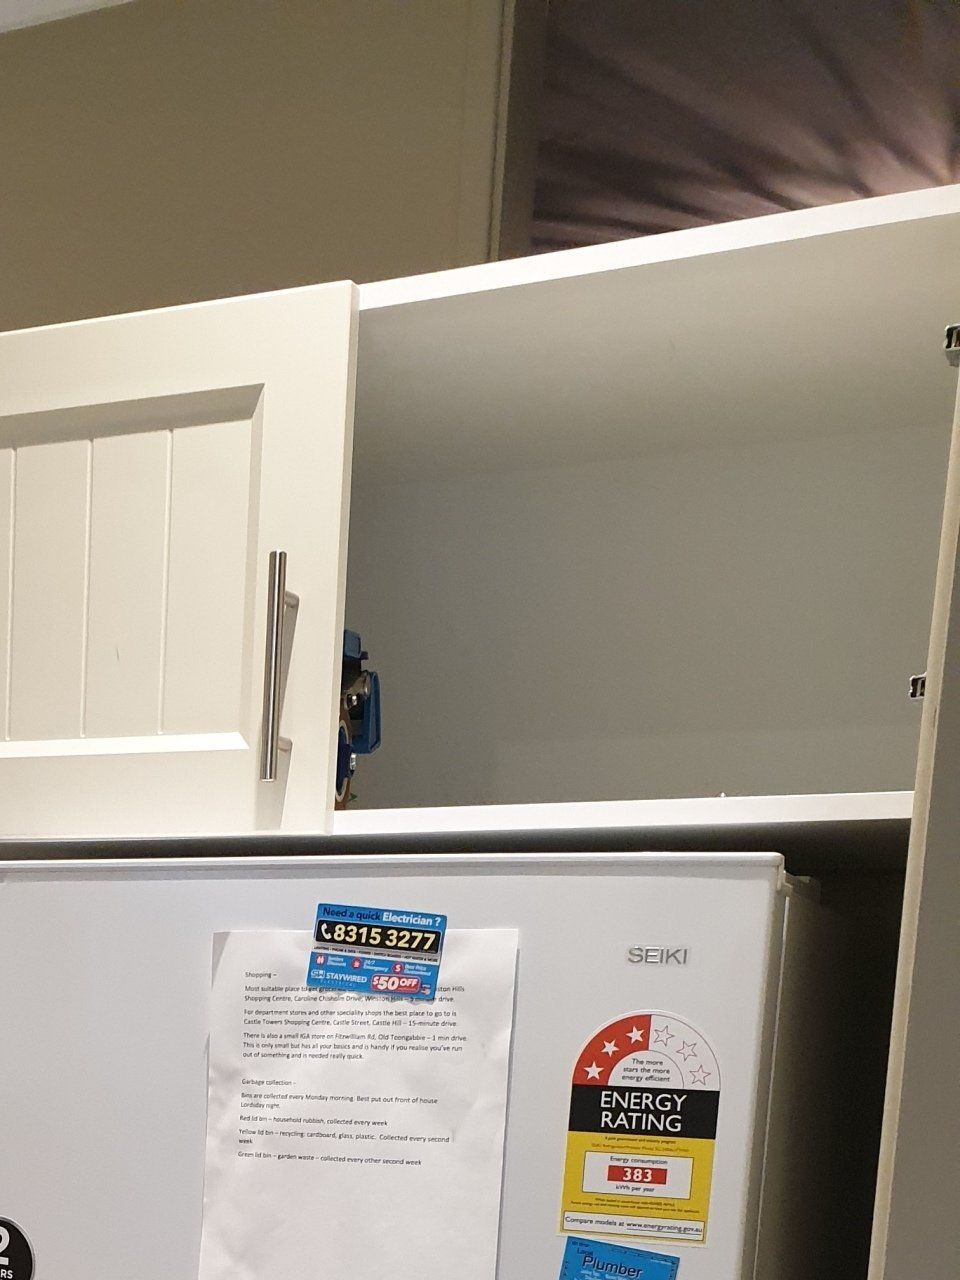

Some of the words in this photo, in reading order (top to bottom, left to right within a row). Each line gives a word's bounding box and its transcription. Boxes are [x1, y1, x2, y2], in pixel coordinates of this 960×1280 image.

[323, 907, 346, 916] Need
[357, 911, 380, 921] quick
[383, 912, 432, 926] Electrician
[435, 917, 441, 926] ?
[334, 924, 381, 944] 8315
[385, 930, 435, 950] 3277
[628, 946, 688, 965] SEIKI
[326, 972, 367, 982] STAYWIRED
[373, 976, 399, 991] $50
[622, 1075, 643, 1083] energy
[645, 1074, 670, 1082] efficient
[600, 1091, 687, 1112] ENERGY
[601, 1111, 682, 1132] RATING
[610, 1156, 629, 1164] Energy
[622, 1168, 652, 1182] 383
[565, 1216, 593, 1225] Compare
[626, 1222, 703, 1233] www.energyrating.gov.au
[582, 1255, 643, 1278] Plumber
